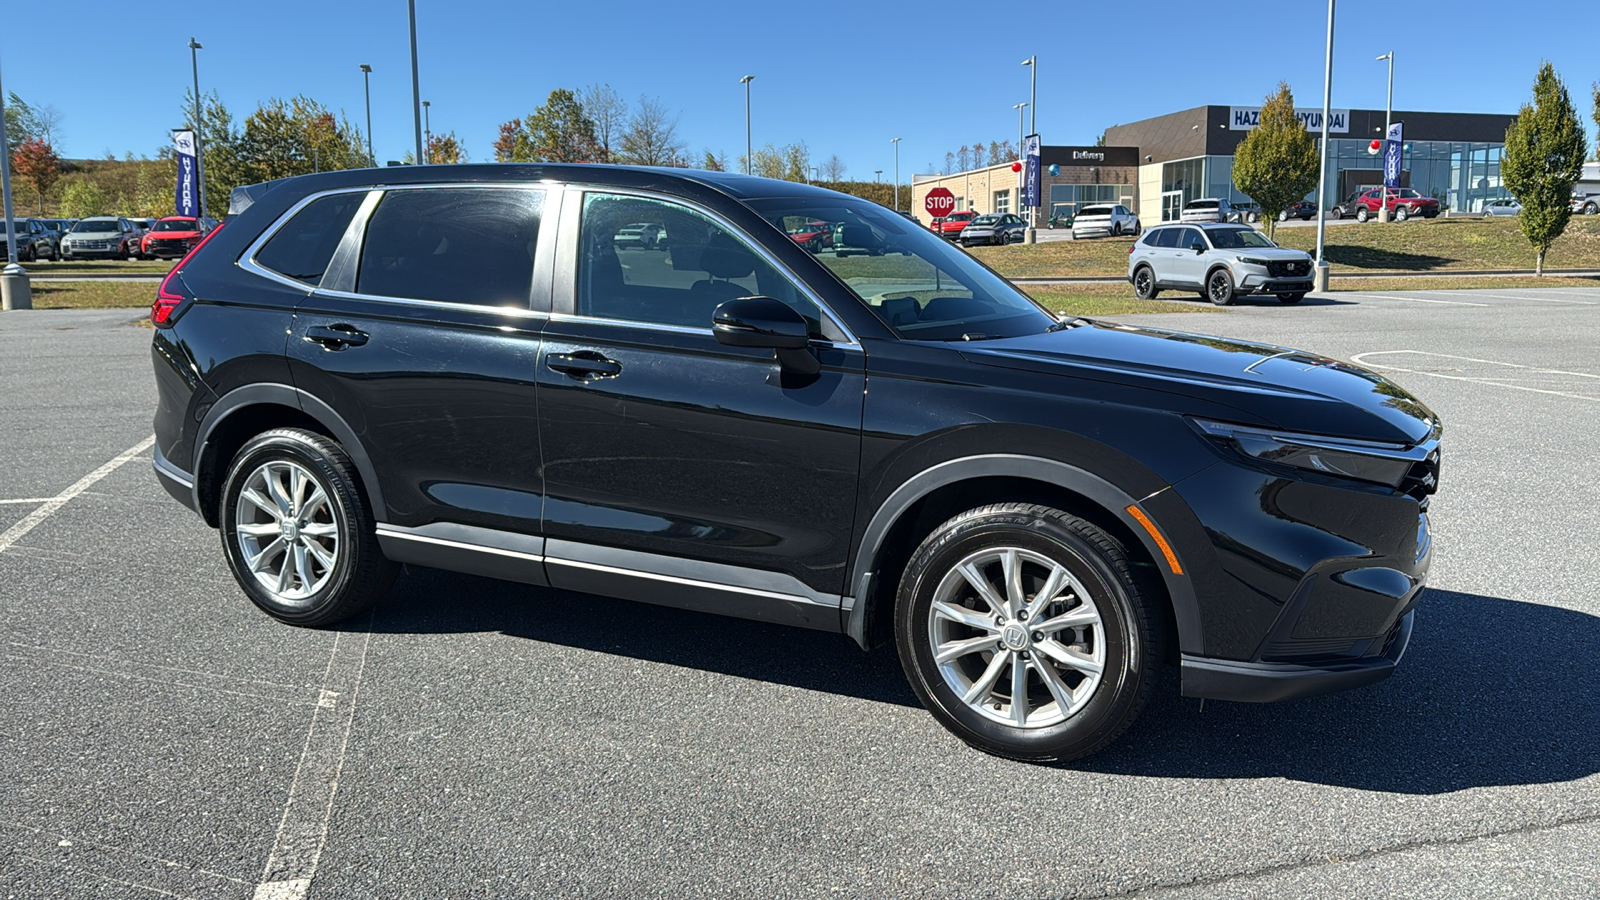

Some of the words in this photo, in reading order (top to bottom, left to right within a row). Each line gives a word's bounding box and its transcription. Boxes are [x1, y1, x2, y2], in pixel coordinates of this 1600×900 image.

[1073, 150, 1104, 162] Delivery
[182, 157, 191, 215] HYUNDAI
[926, 196, 954, 209] STOP
